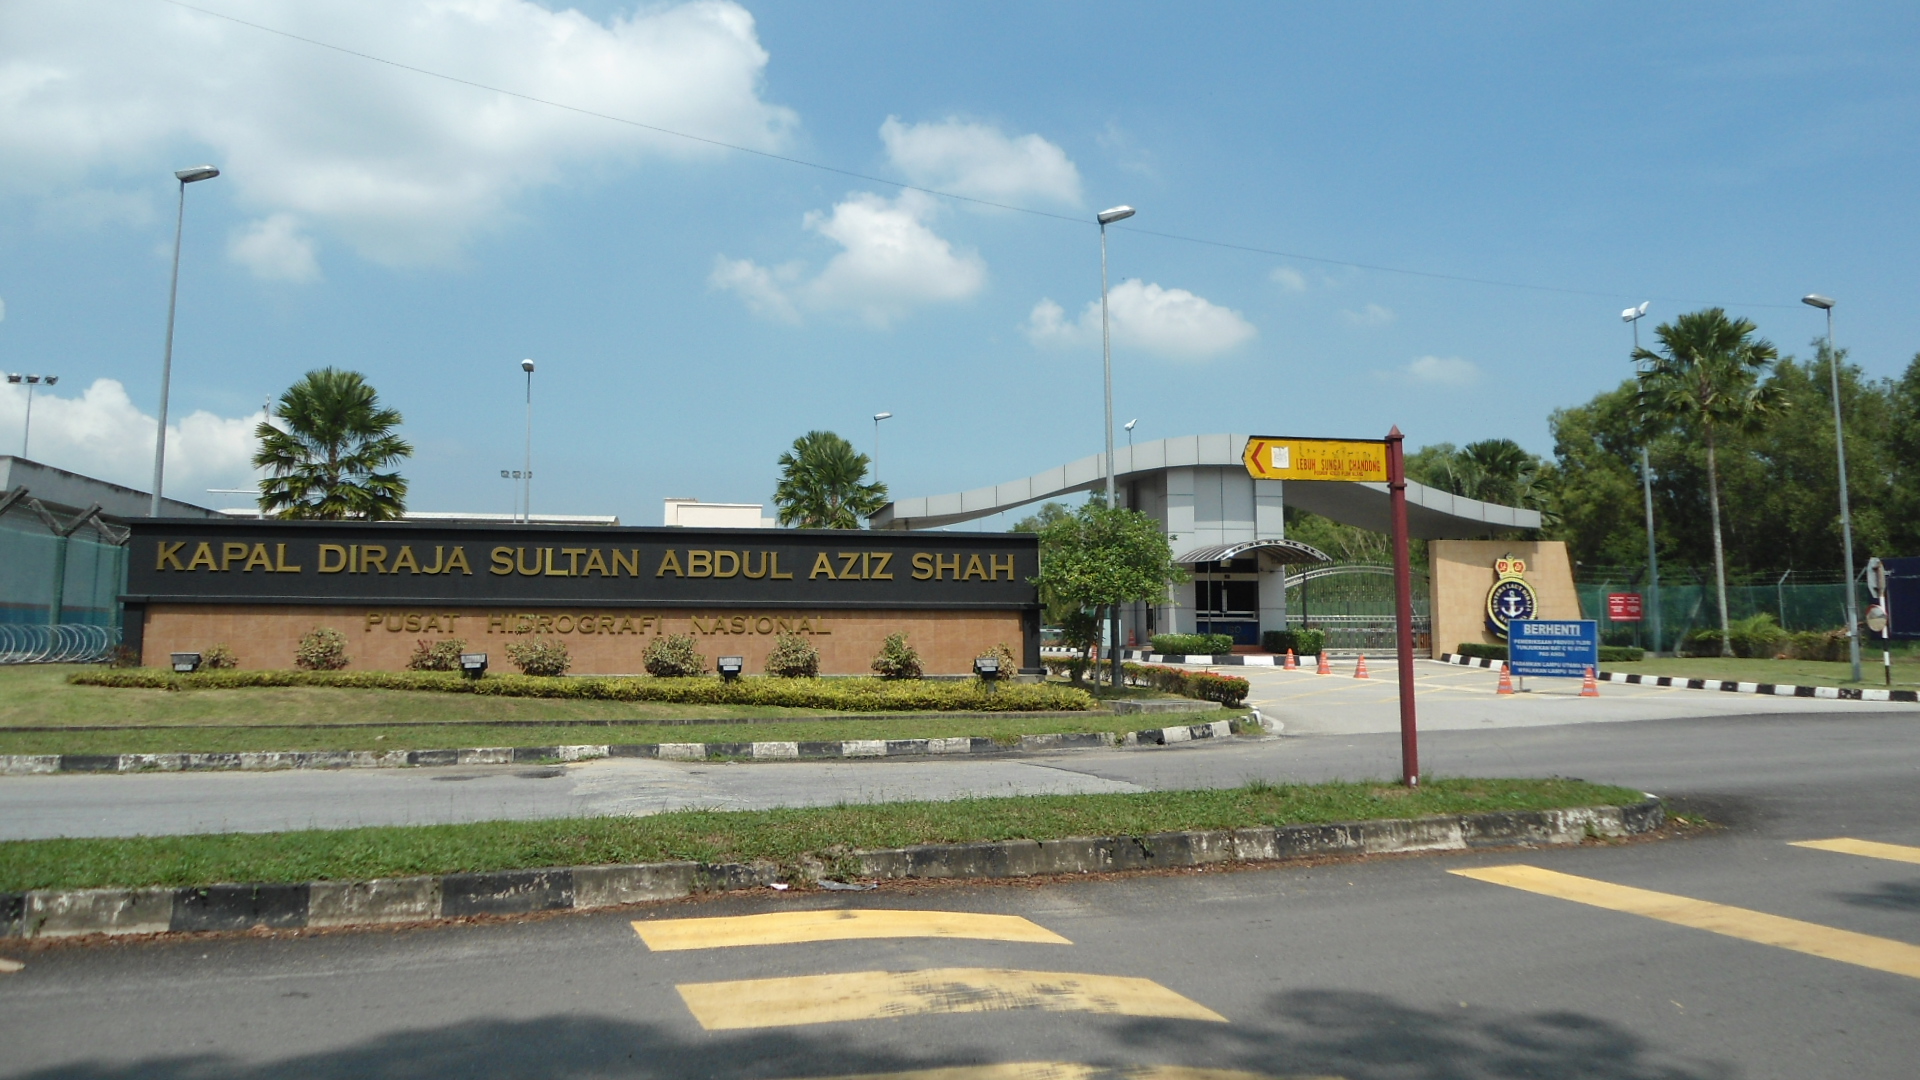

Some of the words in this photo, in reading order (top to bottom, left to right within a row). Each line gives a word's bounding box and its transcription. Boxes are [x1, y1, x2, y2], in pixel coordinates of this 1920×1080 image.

[1297, 459, 1316, 471] LEBUH
[1321, 459, 1344, 471] SUNGAI
[1349, 459, 1381, 473] CHANDONG
[156, 541, 301, 572] KAPAL
[318, 543, 473, 575] DIRAJA
[490, 546, 639, 577] SULTAN
[655, 549, 793, 580] ABDUL
[808, 552, 893, 580] AZIZ
[911, 552, 1014, 581] SHAH
[365, 612, 460, 633] PUSAT
[487, 613, 663, 635] HIDROGRAFI
[690, 615, 832, 635] NASIONAL
[1523, 624, 1581, 636] BERHENTI
